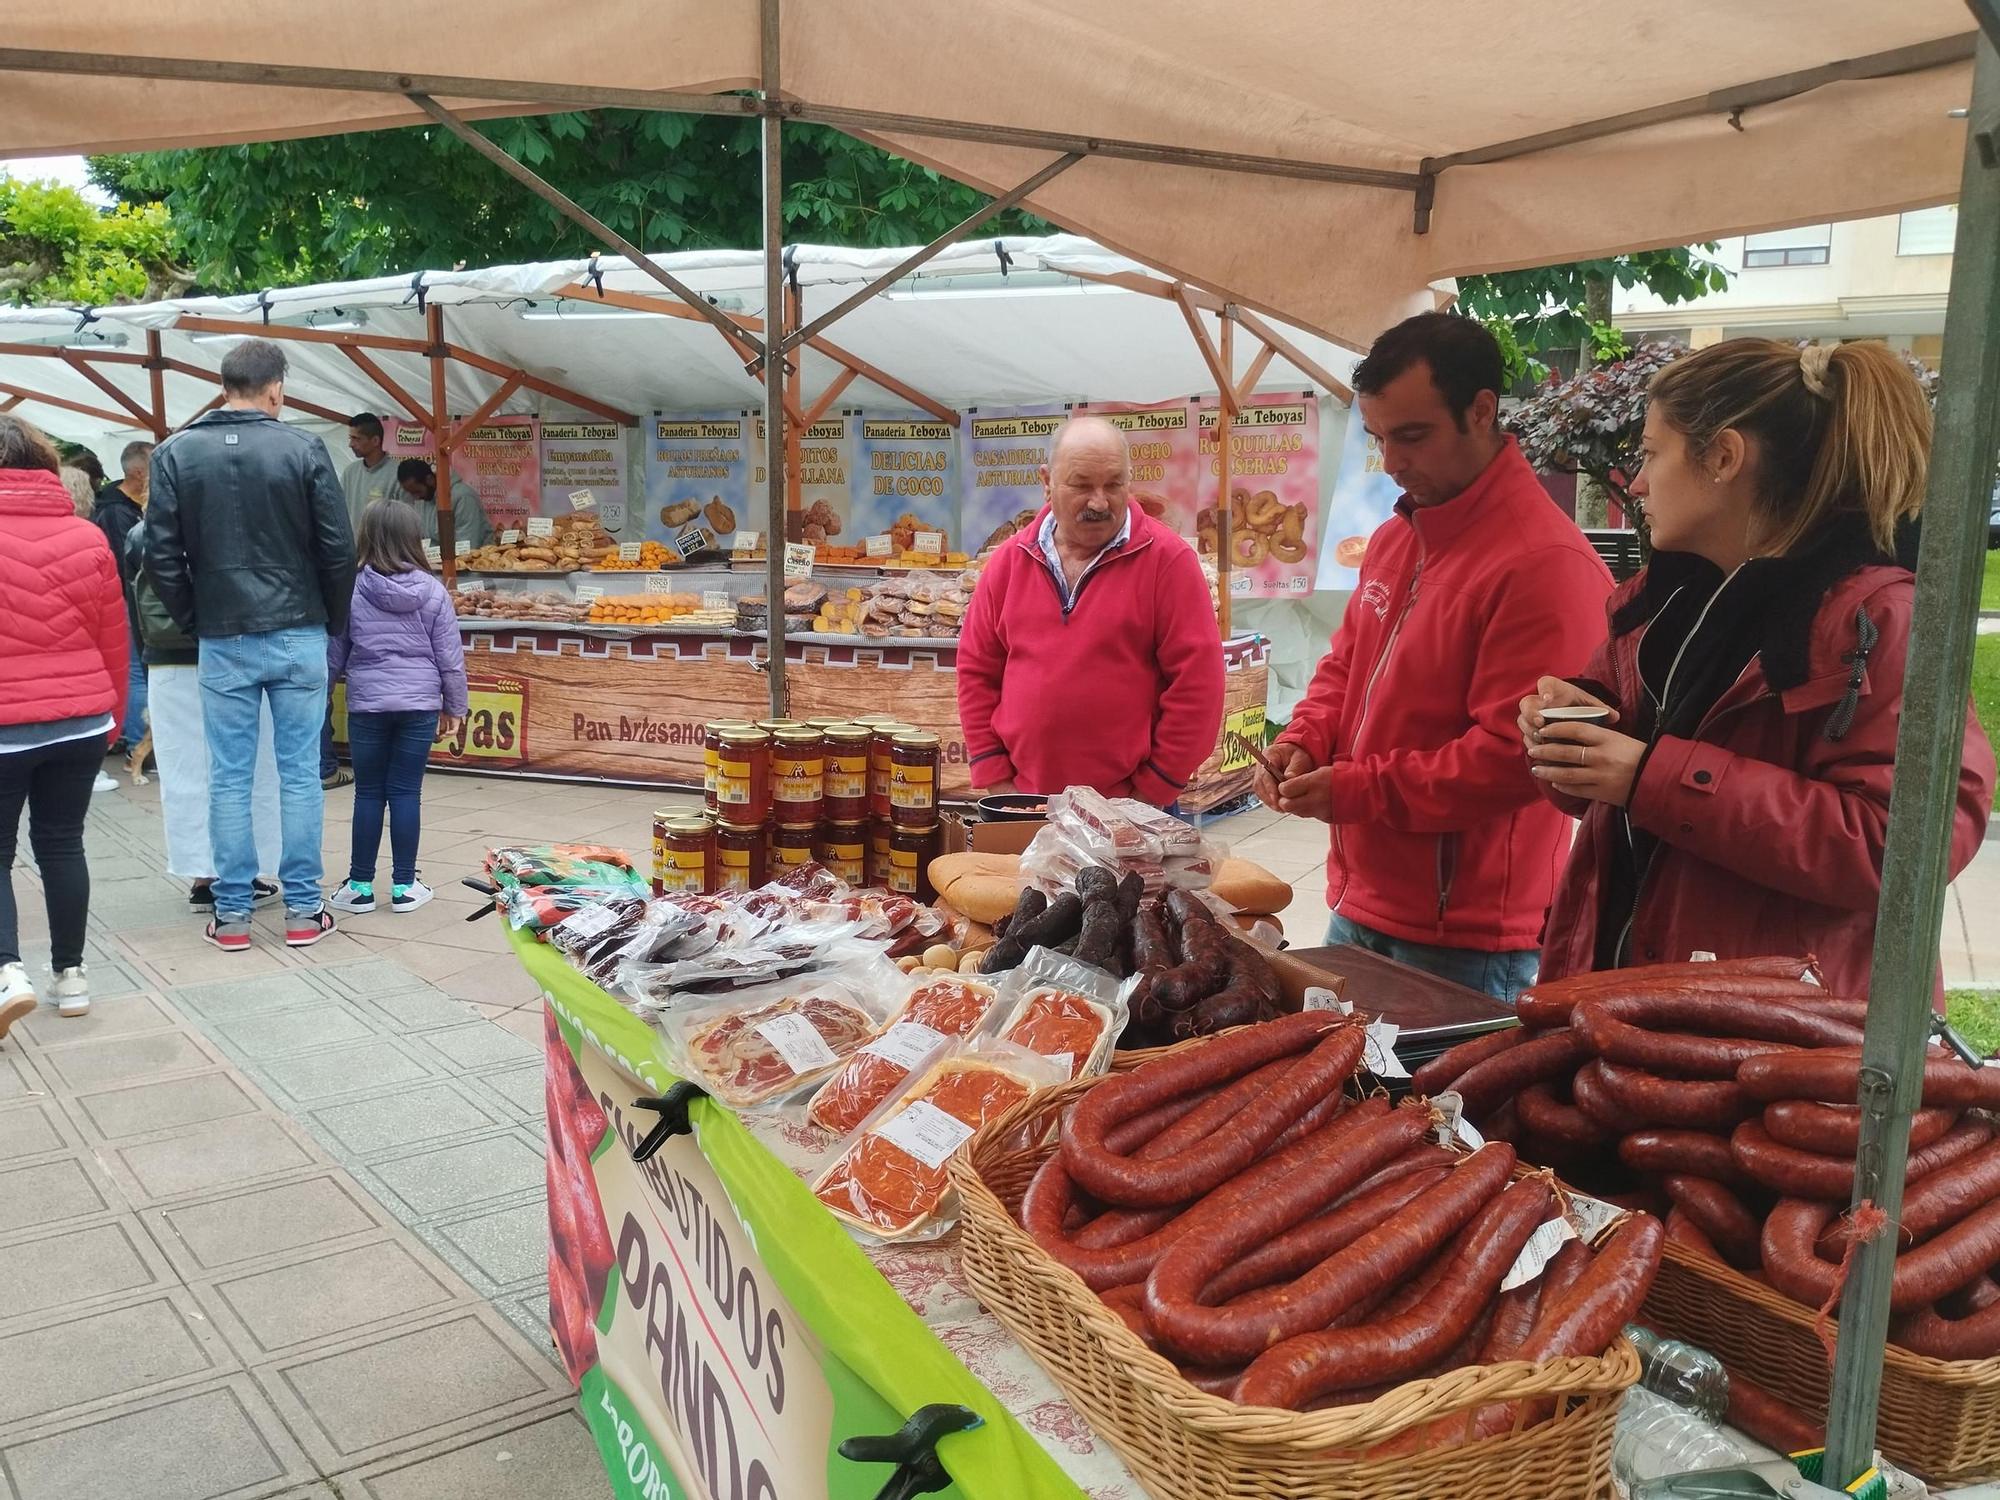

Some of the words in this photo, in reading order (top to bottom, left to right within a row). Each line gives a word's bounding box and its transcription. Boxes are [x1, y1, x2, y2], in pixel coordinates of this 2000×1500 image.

[1138, 415, 1184, 428] Teboyas
[1254, 410, 1303, 424] Teboyas
[500, 430, 532, 440] Teboyas
[582, 426, 616, 439] Teboyas
[701, 425, 738, 438] Teboyas
[803, 426, 841, 438] eboyas
[910, 425, 951, 438] Teboyas
[1199, 433, 1303, 457] ROQUILLAS
[871, 451, 946, 471] DELICIAS
[974, 448, 1048, 466] CASADIELL
[1211, 456, 1288, 476] CSERAS
[755, 467, 766, 483] D
[874, 476, 894, 496] DE
[896, 476, 944, 496] COCO
[1263, 580, 1289, 589] Sueltas
[574, 712, 612, 741] Pan
[620, 715, 706, 746] Artesano
